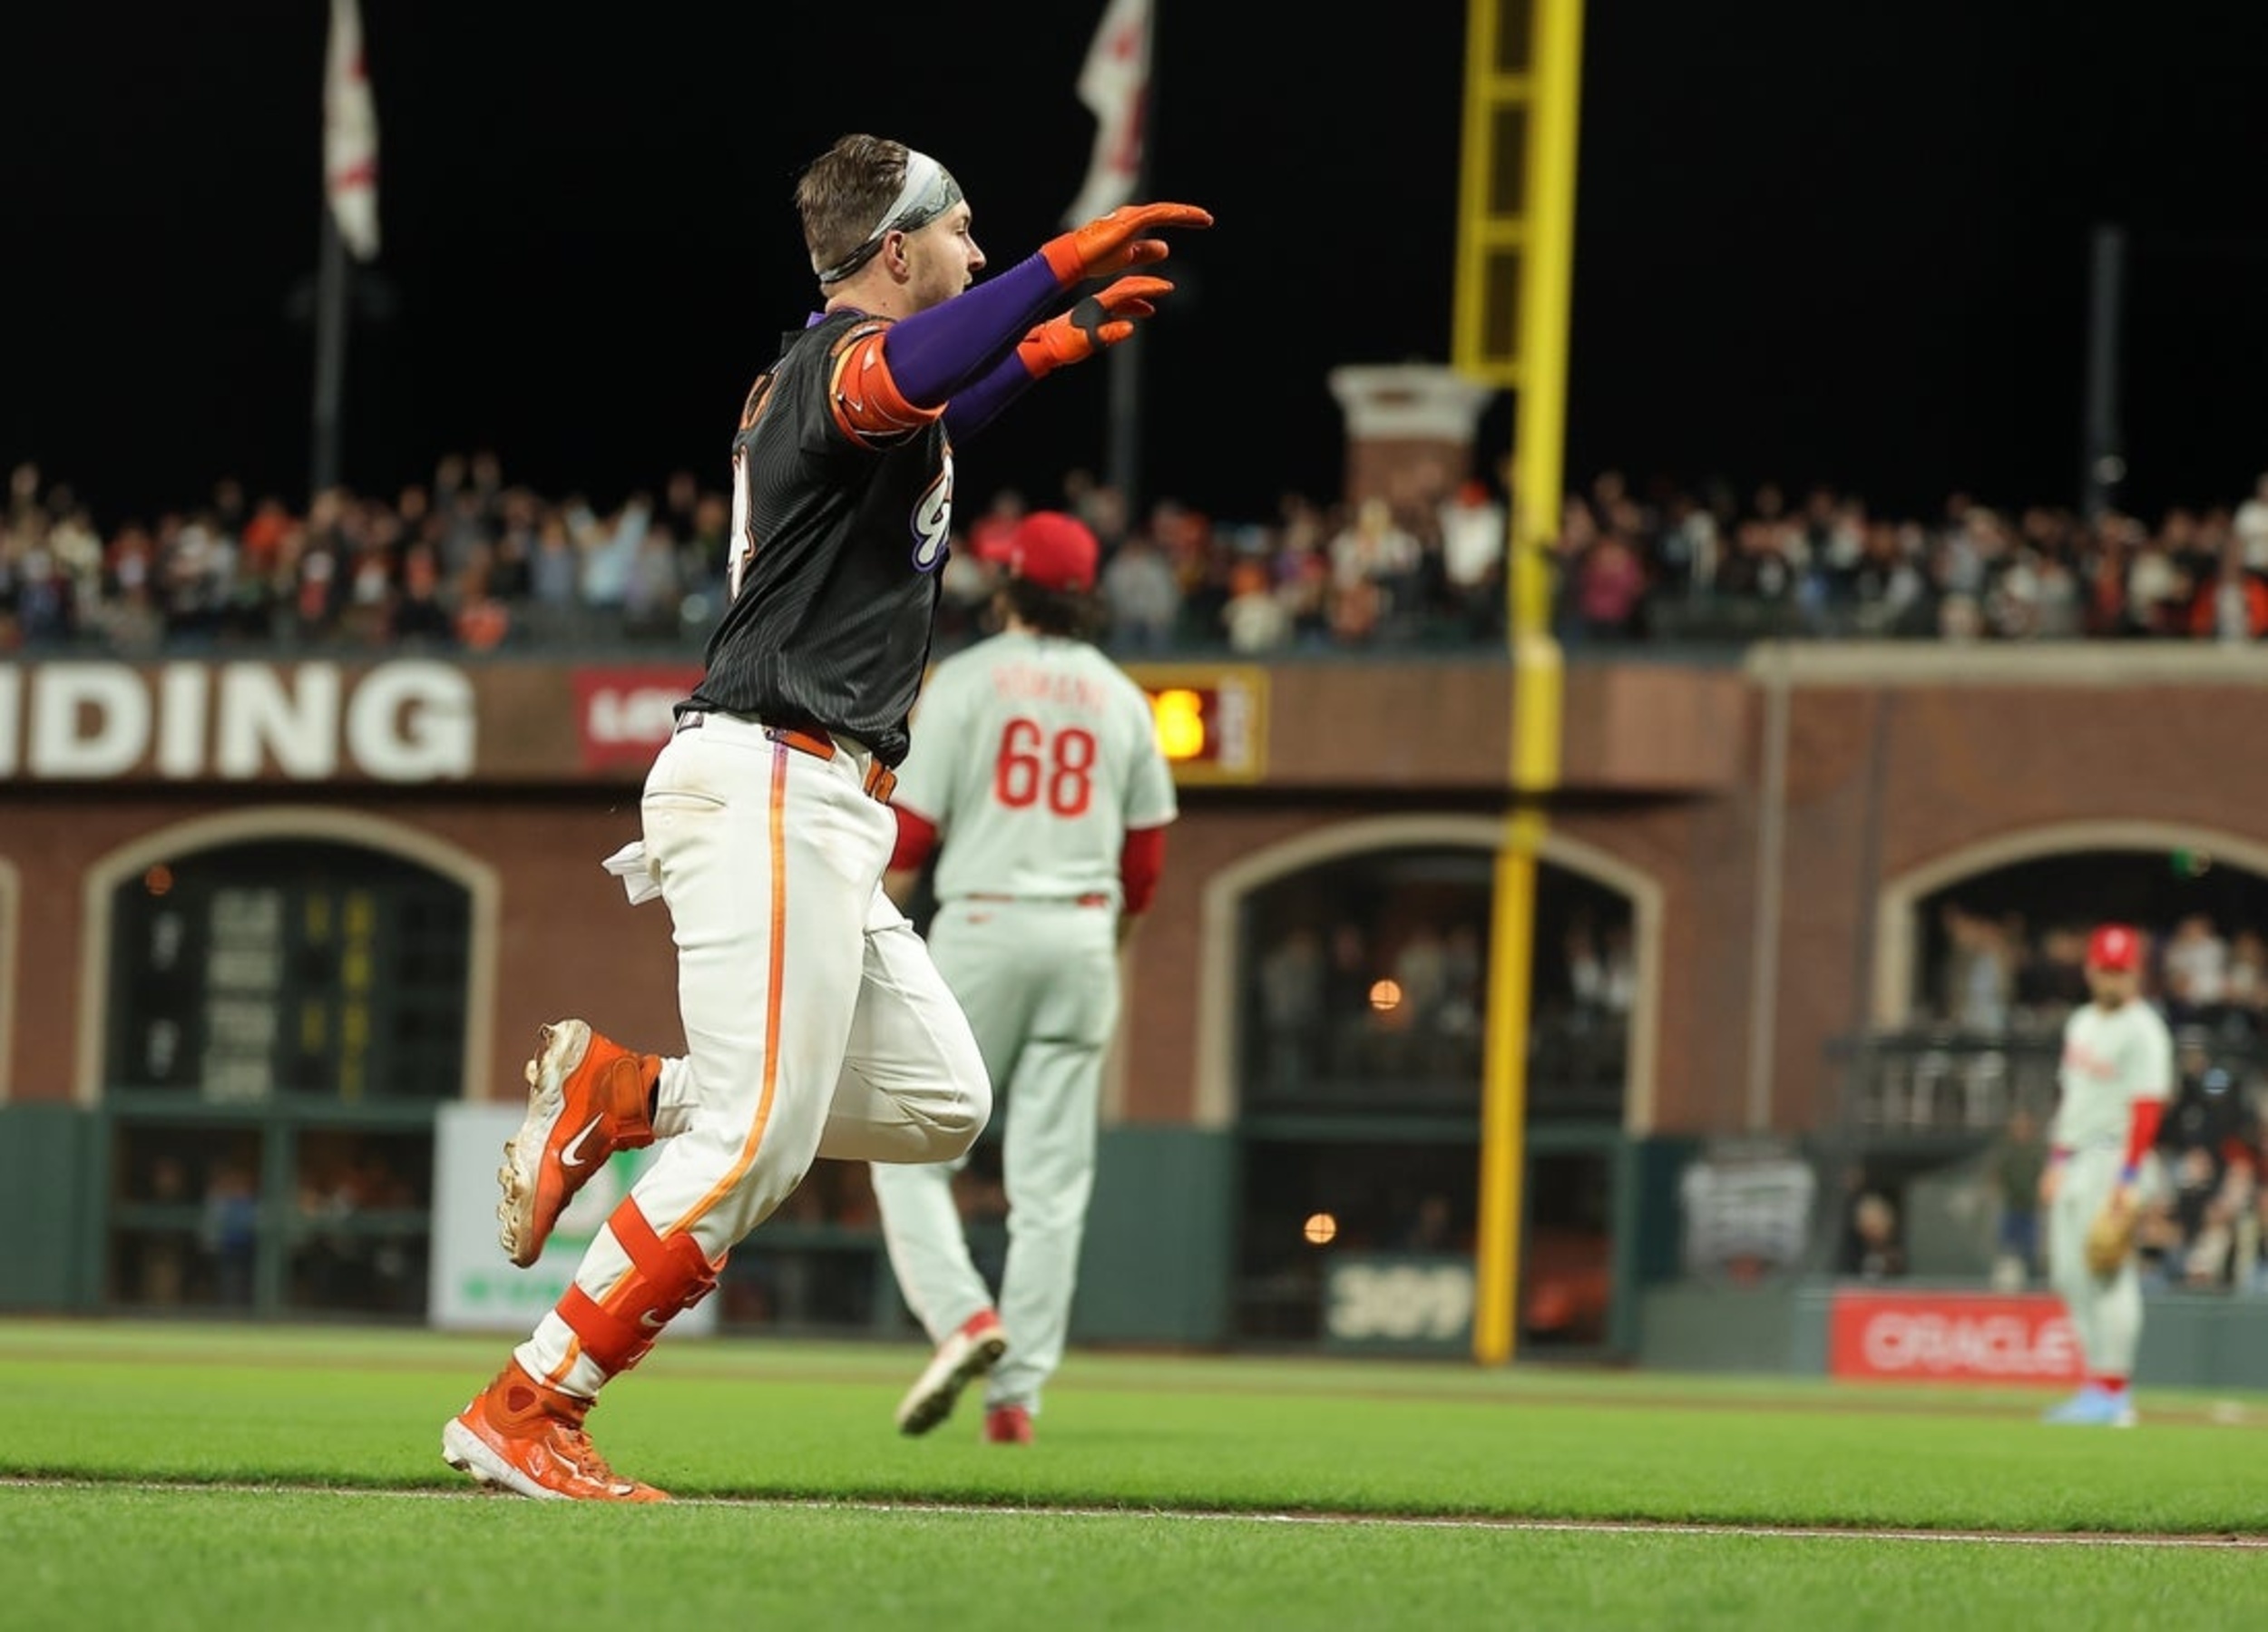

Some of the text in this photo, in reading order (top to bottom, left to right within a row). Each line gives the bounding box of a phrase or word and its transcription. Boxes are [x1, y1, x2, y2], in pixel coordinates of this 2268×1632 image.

[0, 662, 475, 778] DING
[995, 718, 1096, 817] 68
[1863, 1312, 2077, 1374] ORACLE
